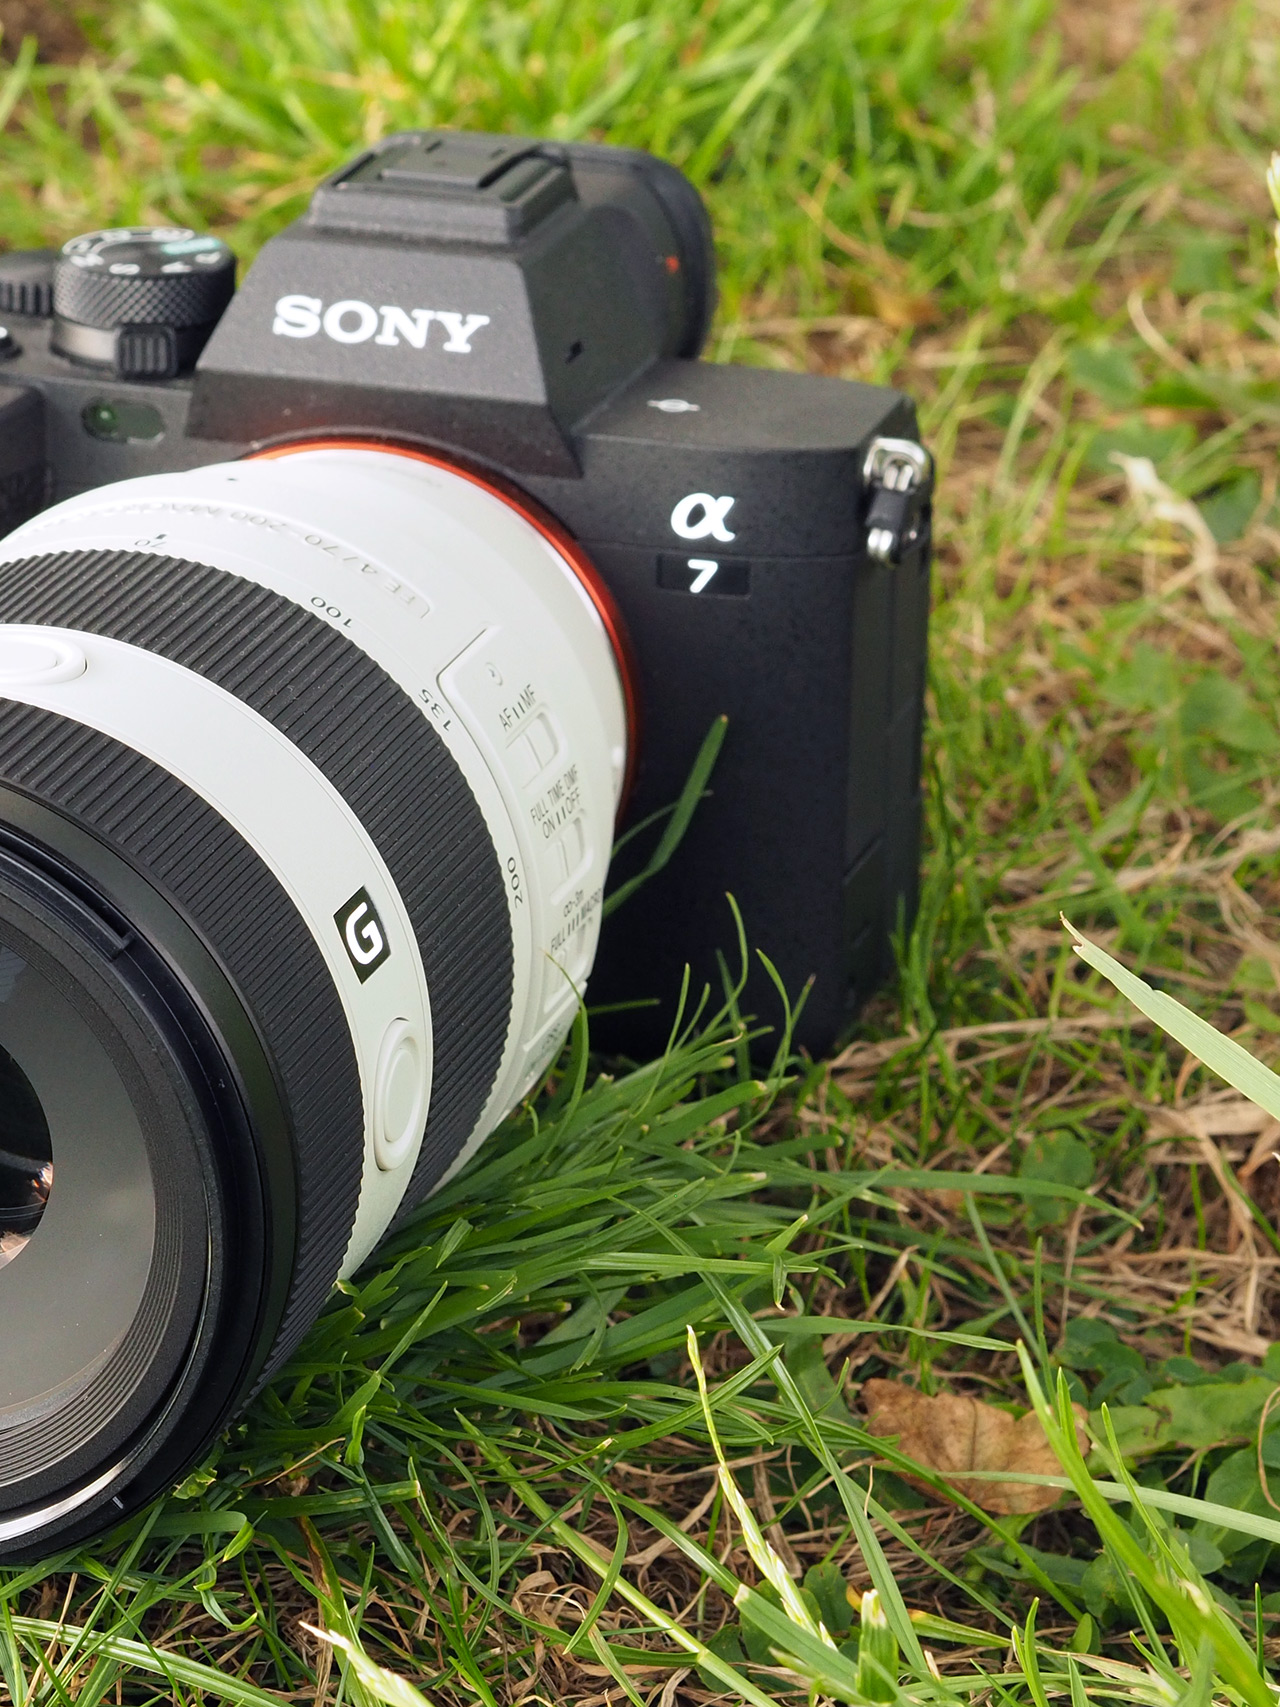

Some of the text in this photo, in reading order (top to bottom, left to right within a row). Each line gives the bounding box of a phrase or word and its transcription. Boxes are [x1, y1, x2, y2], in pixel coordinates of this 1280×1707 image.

[272, 294, 490, 353] SONY
[687, 558, 719, 594] 7
[310, 596, 353, 628] 100
[418, 688, 452, 732] 135
[498, 683, 536, 732] AF MF
[530, 798, 549, 827] FULL
[547, 778, 565, 807] TIME
[542, 786, 580, 839] ON OFF
[507, 856, 524, 909] 200
[345, 901, 384, 965] G
